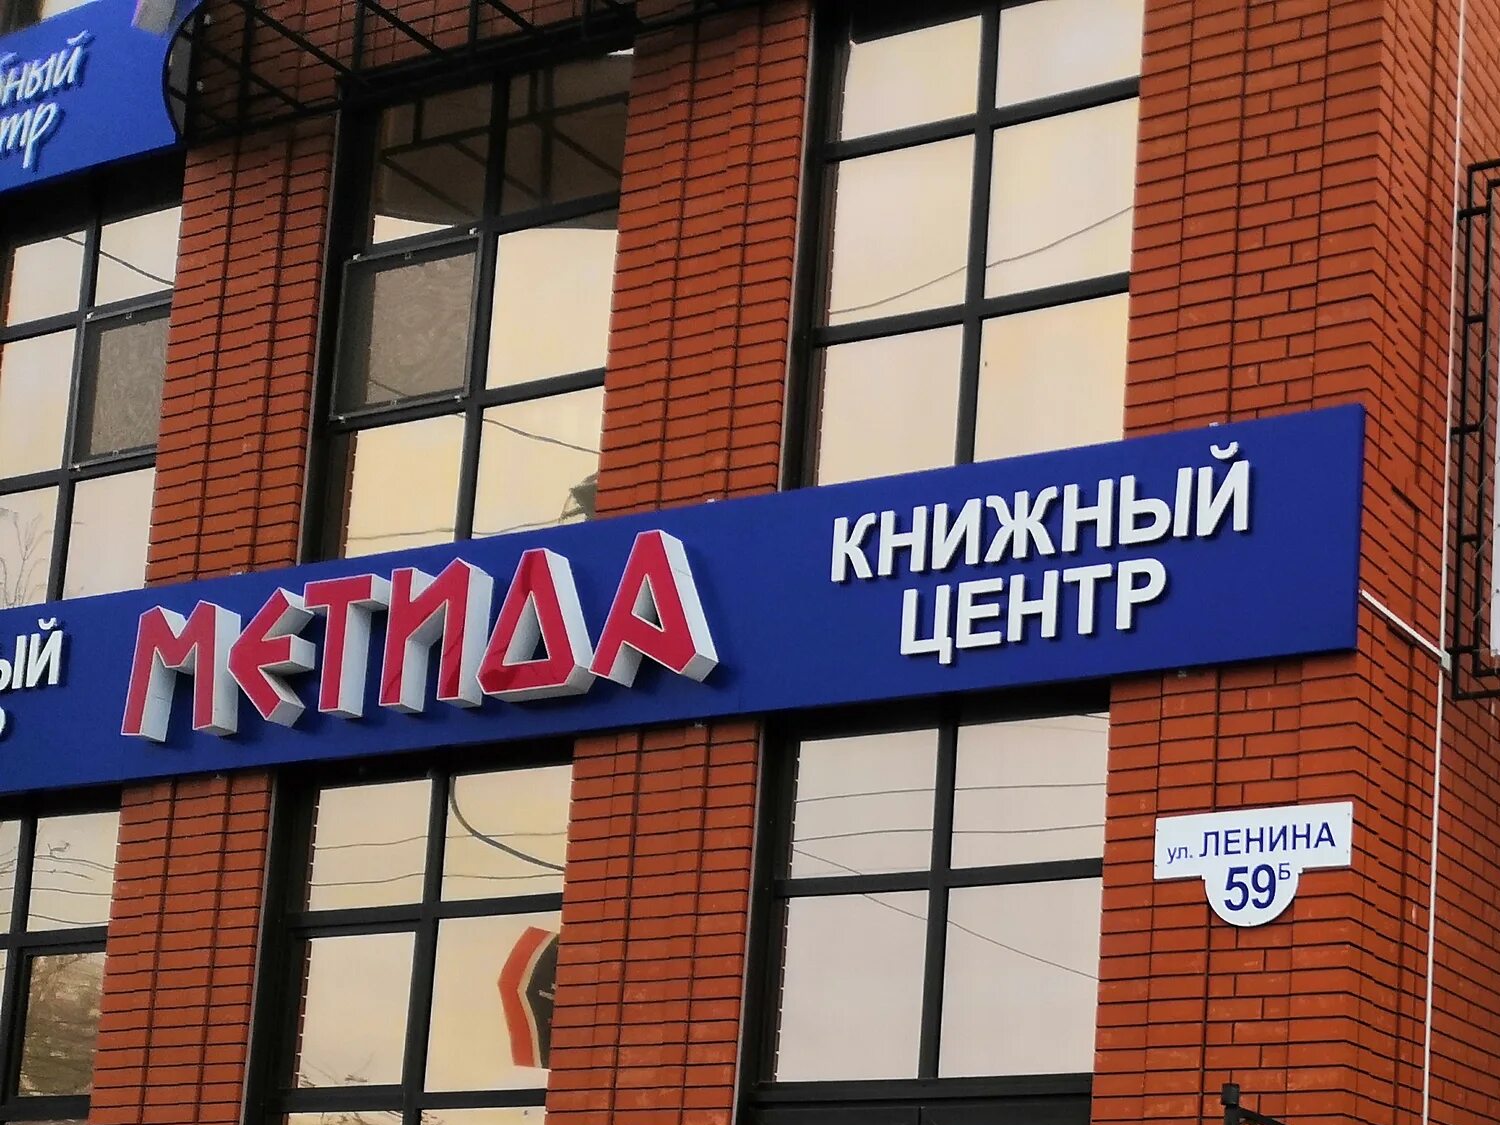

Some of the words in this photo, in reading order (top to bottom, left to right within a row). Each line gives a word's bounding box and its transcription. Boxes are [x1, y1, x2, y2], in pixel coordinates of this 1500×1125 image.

[830, 441, 1250, 583] КНИЖНЫЙ
[120, 529, 719, 743] МЕТИДА
[900, 556, 1167, 665] ЦЕНТР
[1166, 843, 1194, 863] ул.
[1199, 821, 1337, 858] ЛЕНИНА
